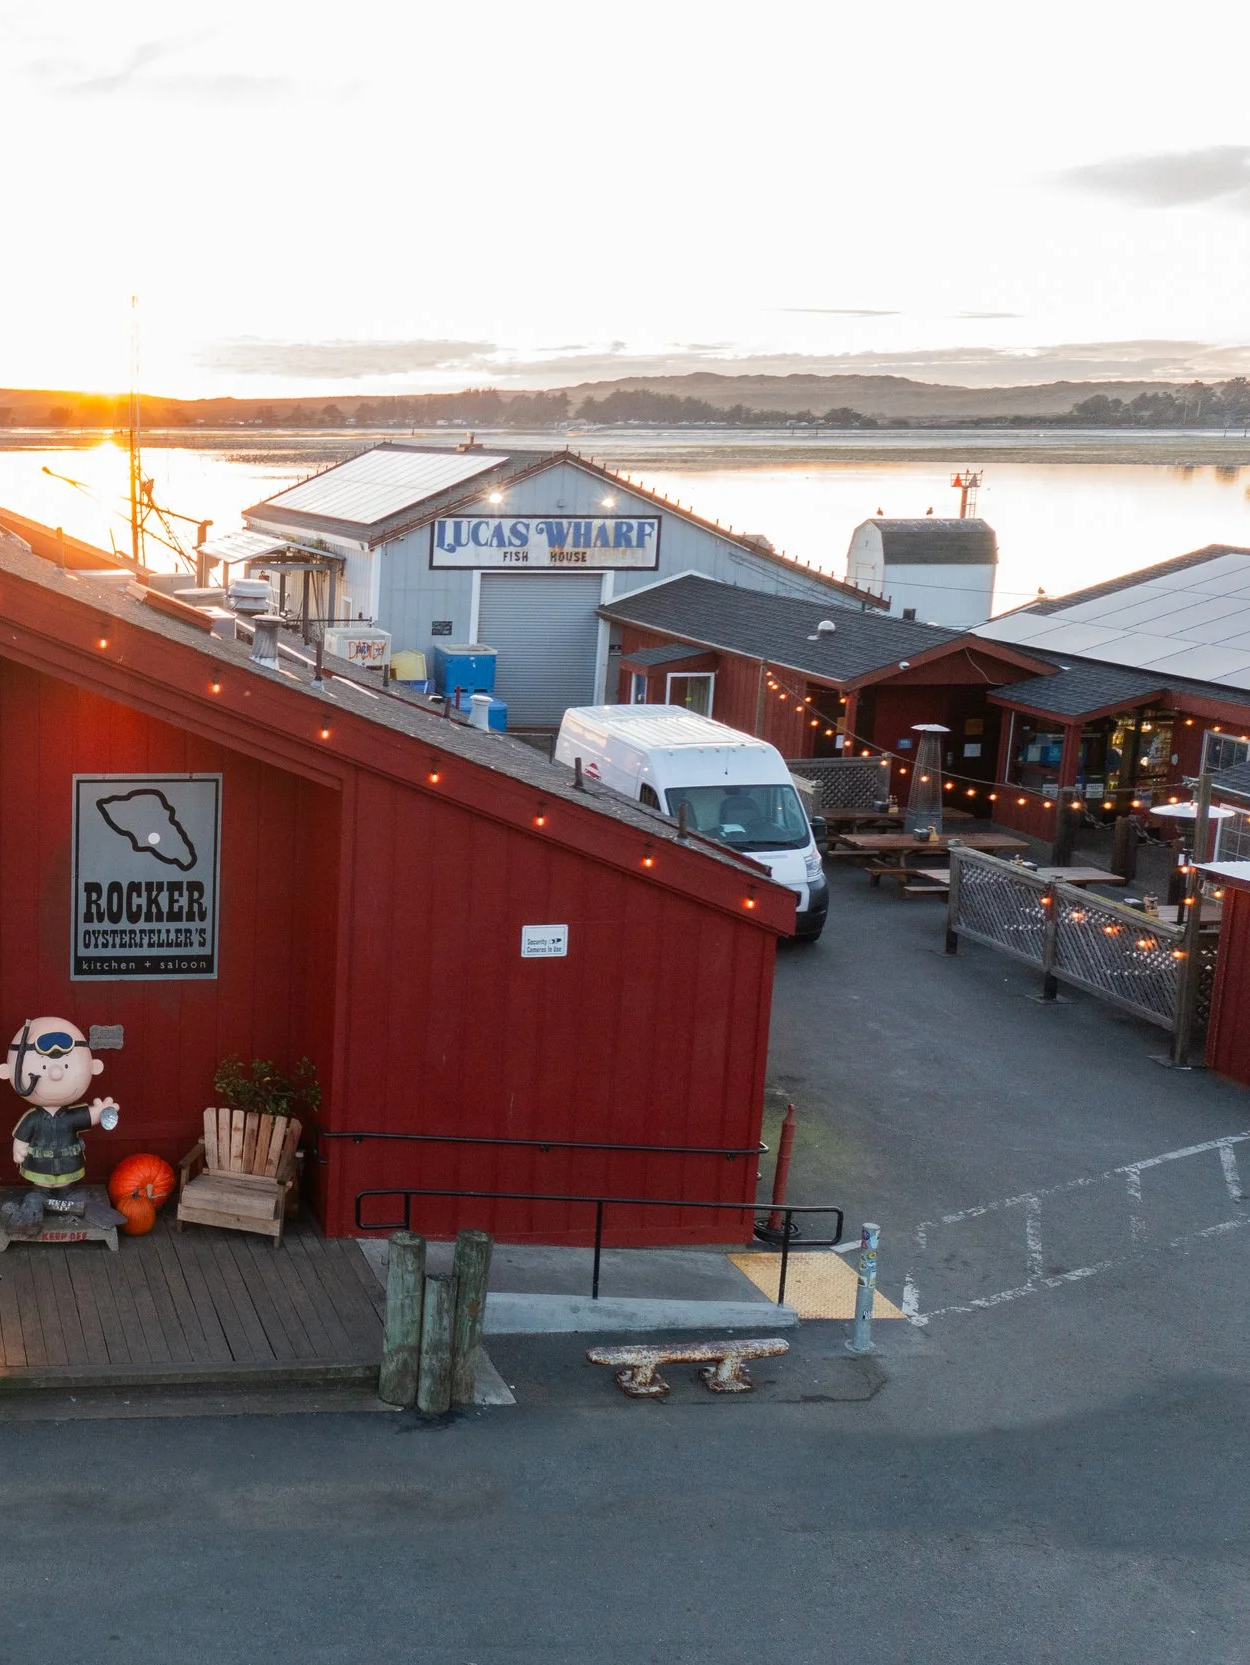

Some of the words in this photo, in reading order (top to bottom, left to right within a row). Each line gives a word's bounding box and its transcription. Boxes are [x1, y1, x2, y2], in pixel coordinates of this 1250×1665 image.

[435, 519, 531, 553] LUCAS
[535, 519, 655, 549] WHARF
[502, 551, 529, 562] FISH
[550, 551, 587, 562] HOUSE
[83, 880, 207, 924] ROCKER
[82, 928, 207, 949] OYSTERFELLER'S
[82, 960, 136, 970] kitchen
[160, 959, 207, 969] saloon
[41, 1232, 68, 1240] KEEP
